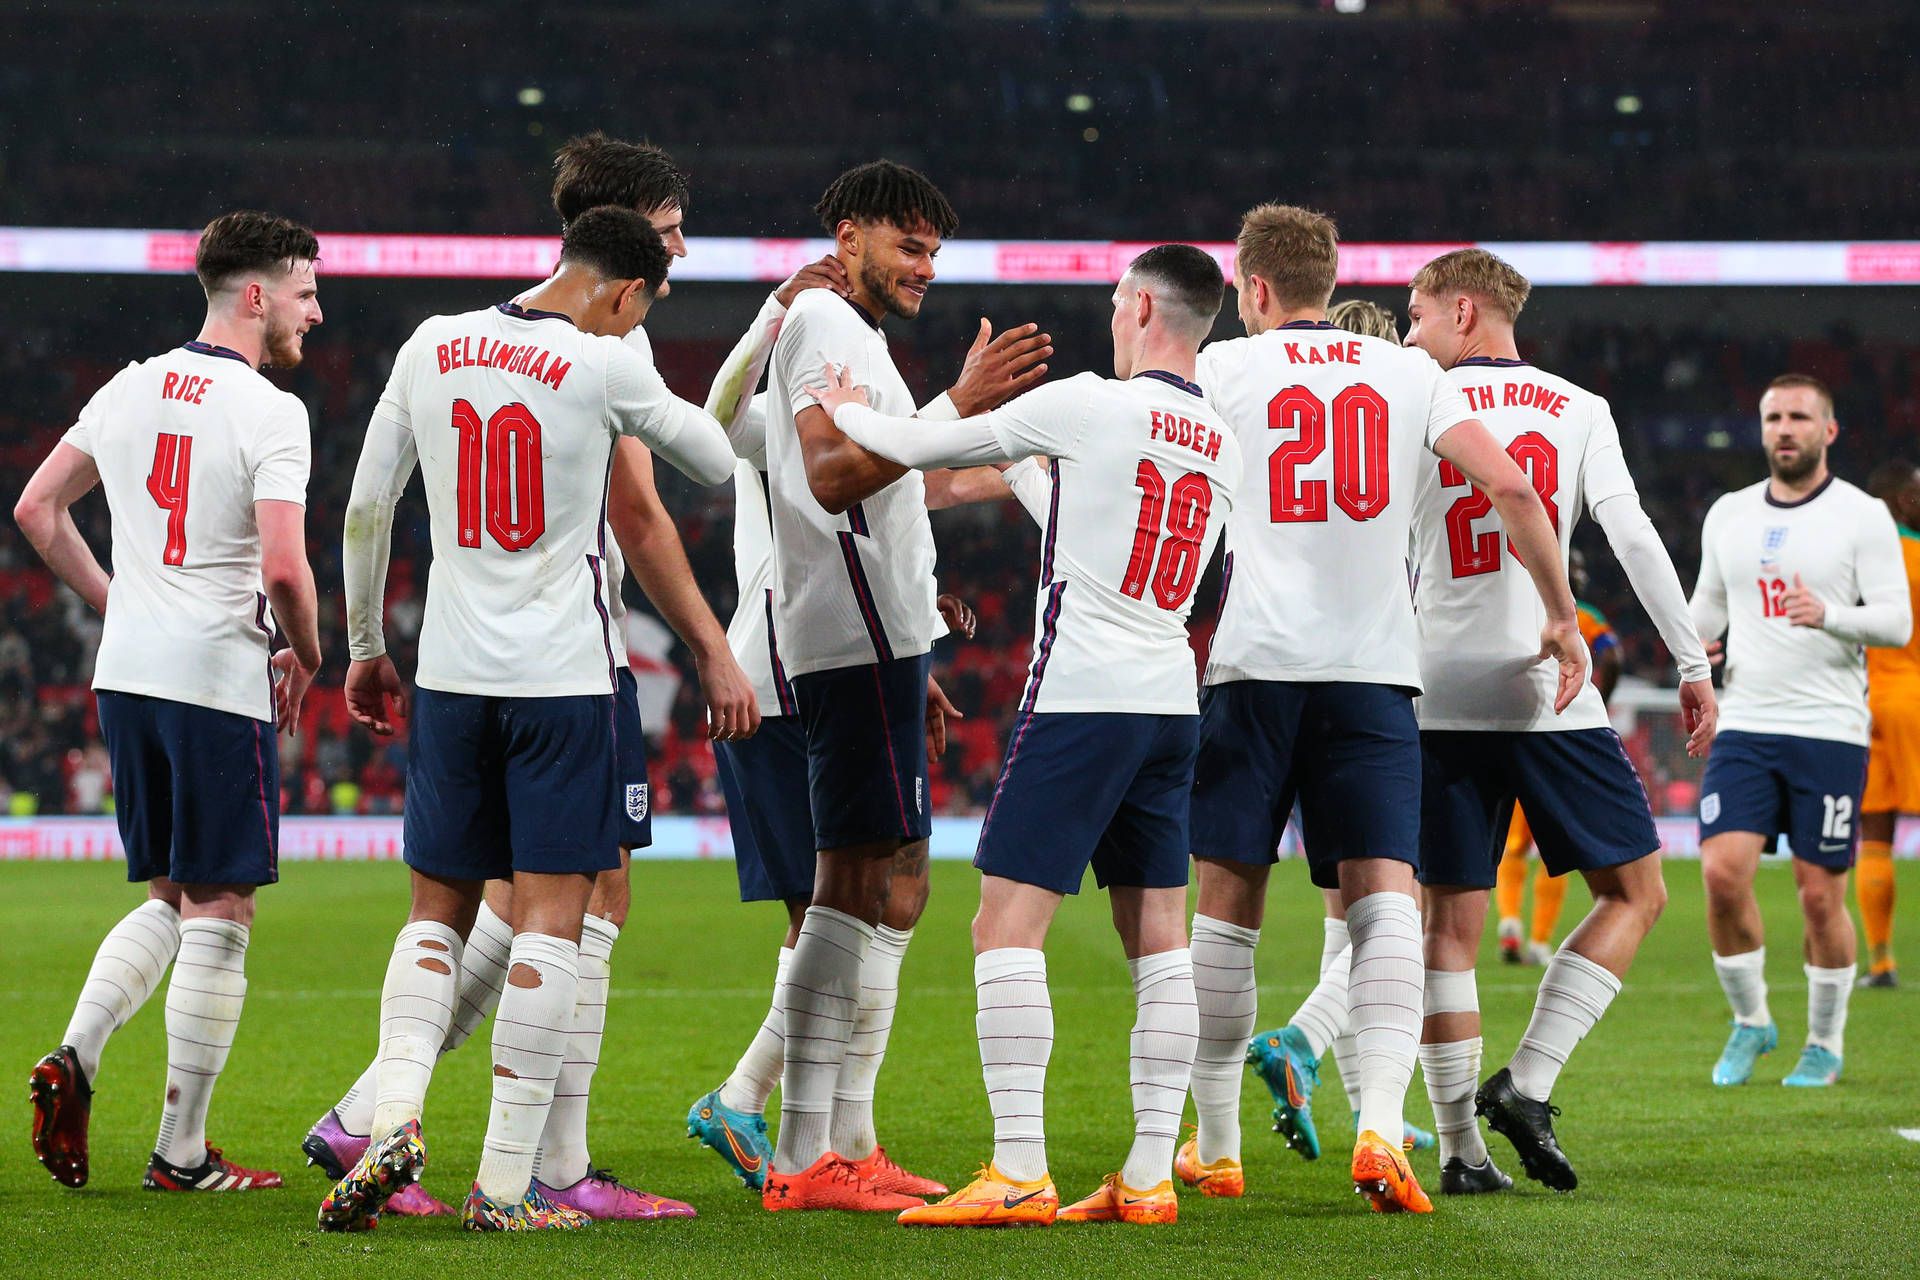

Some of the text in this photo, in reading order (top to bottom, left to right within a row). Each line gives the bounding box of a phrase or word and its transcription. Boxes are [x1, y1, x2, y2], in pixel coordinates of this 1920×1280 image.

[436, 336, 573, 391] BELLINGHAM
[1283, 341, 1362, 365] KANE
[162, 371, 213, 405] RICE
[1503, 382, 1570, 418] ROWE
[1150, 410, 1222, 462] FODEN
[1267, 382, 1390, 523] 20
[146, 432, 193, 566] 4
[451, 398, 546, 552] 10
[1119, 458, 1213, 612] 18
[1757, 578, 1787, 618] 12
[1822, 794, 1853, 839] 12
